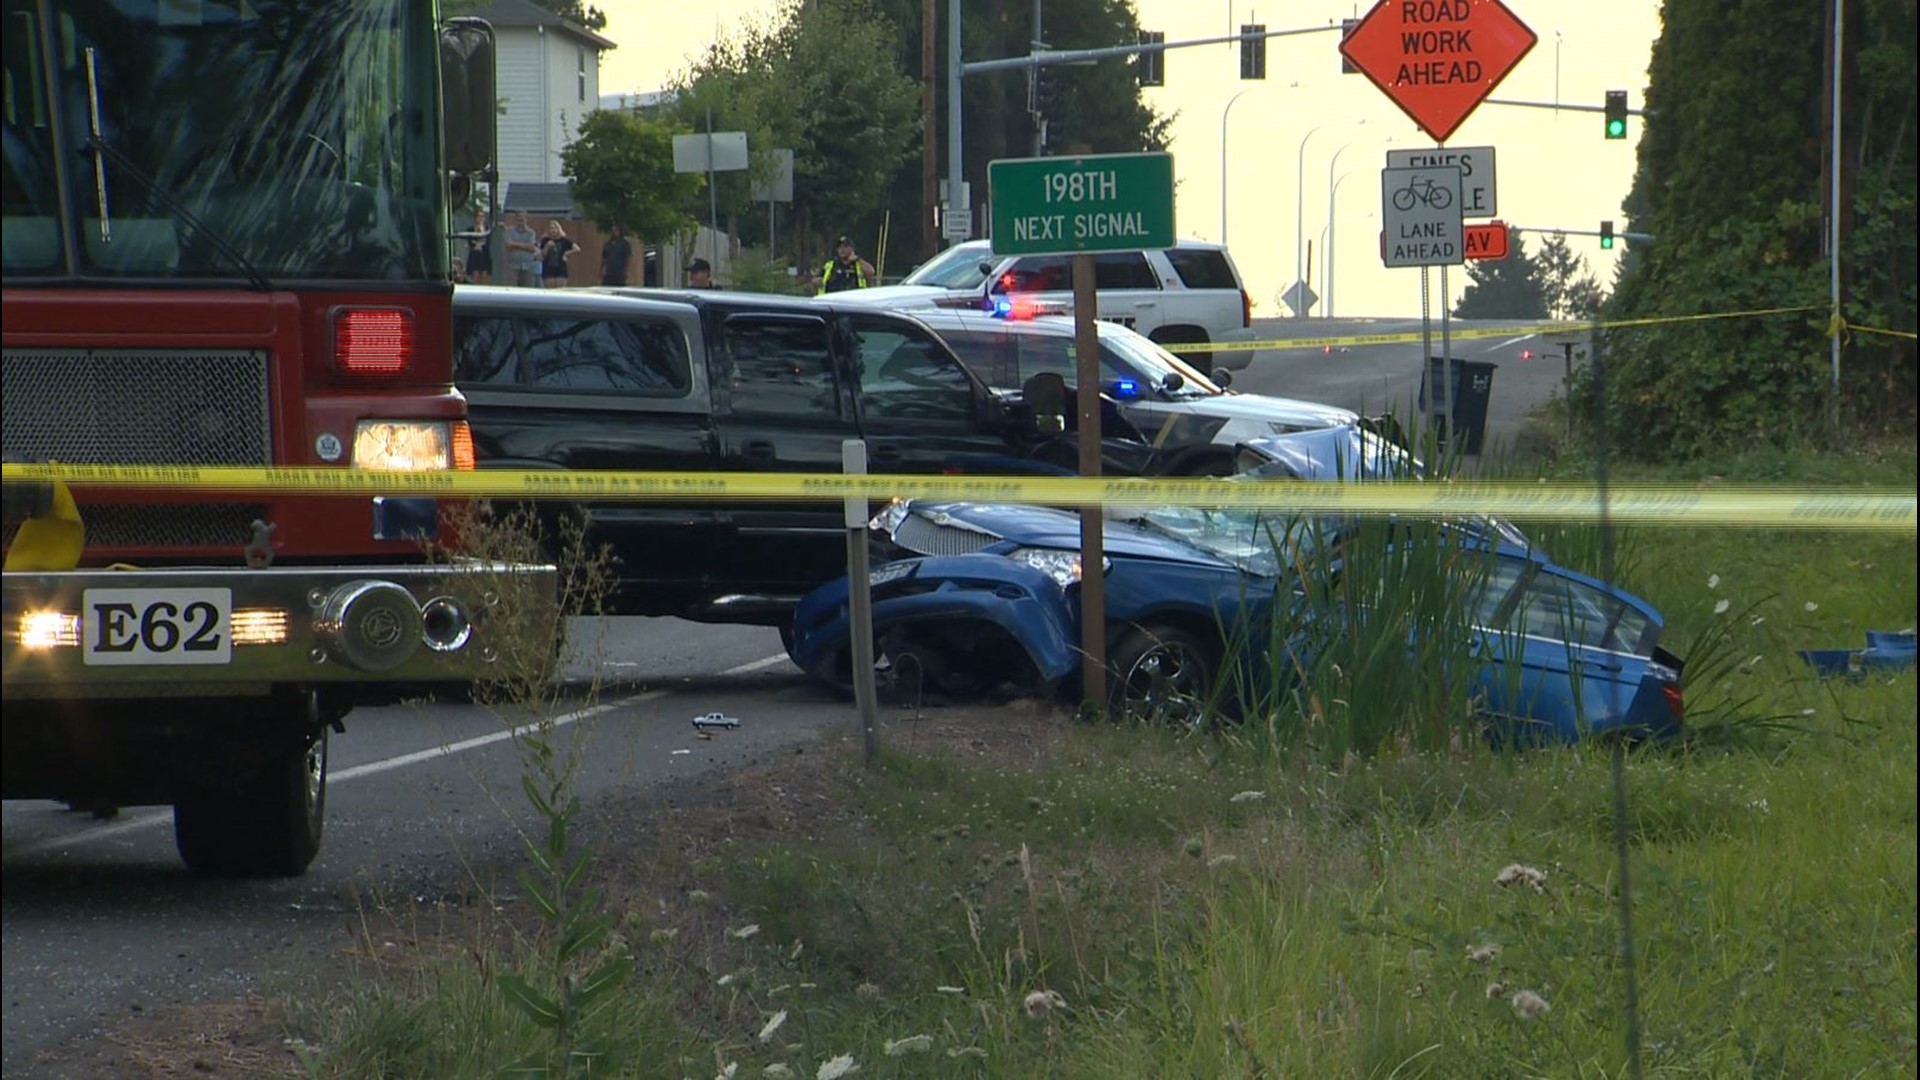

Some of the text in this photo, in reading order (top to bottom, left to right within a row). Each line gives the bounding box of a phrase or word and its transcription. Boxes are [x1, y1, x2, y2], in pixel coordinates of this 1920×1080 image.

[1402, 0, 1470, 23] ROAD
[1401, 30, 1472, 54] WORK
[1395, 61, 1482, 86] AHEAD
[1043, 170, 1117, 202] 198TH
[1014, 211, 1150, 241] NEXT SIGNAL
[1401, 222, 1447, 239] LANE
[1393, 242, 1455, 259] AHEAD
[93, 601, 220, 653] E62
